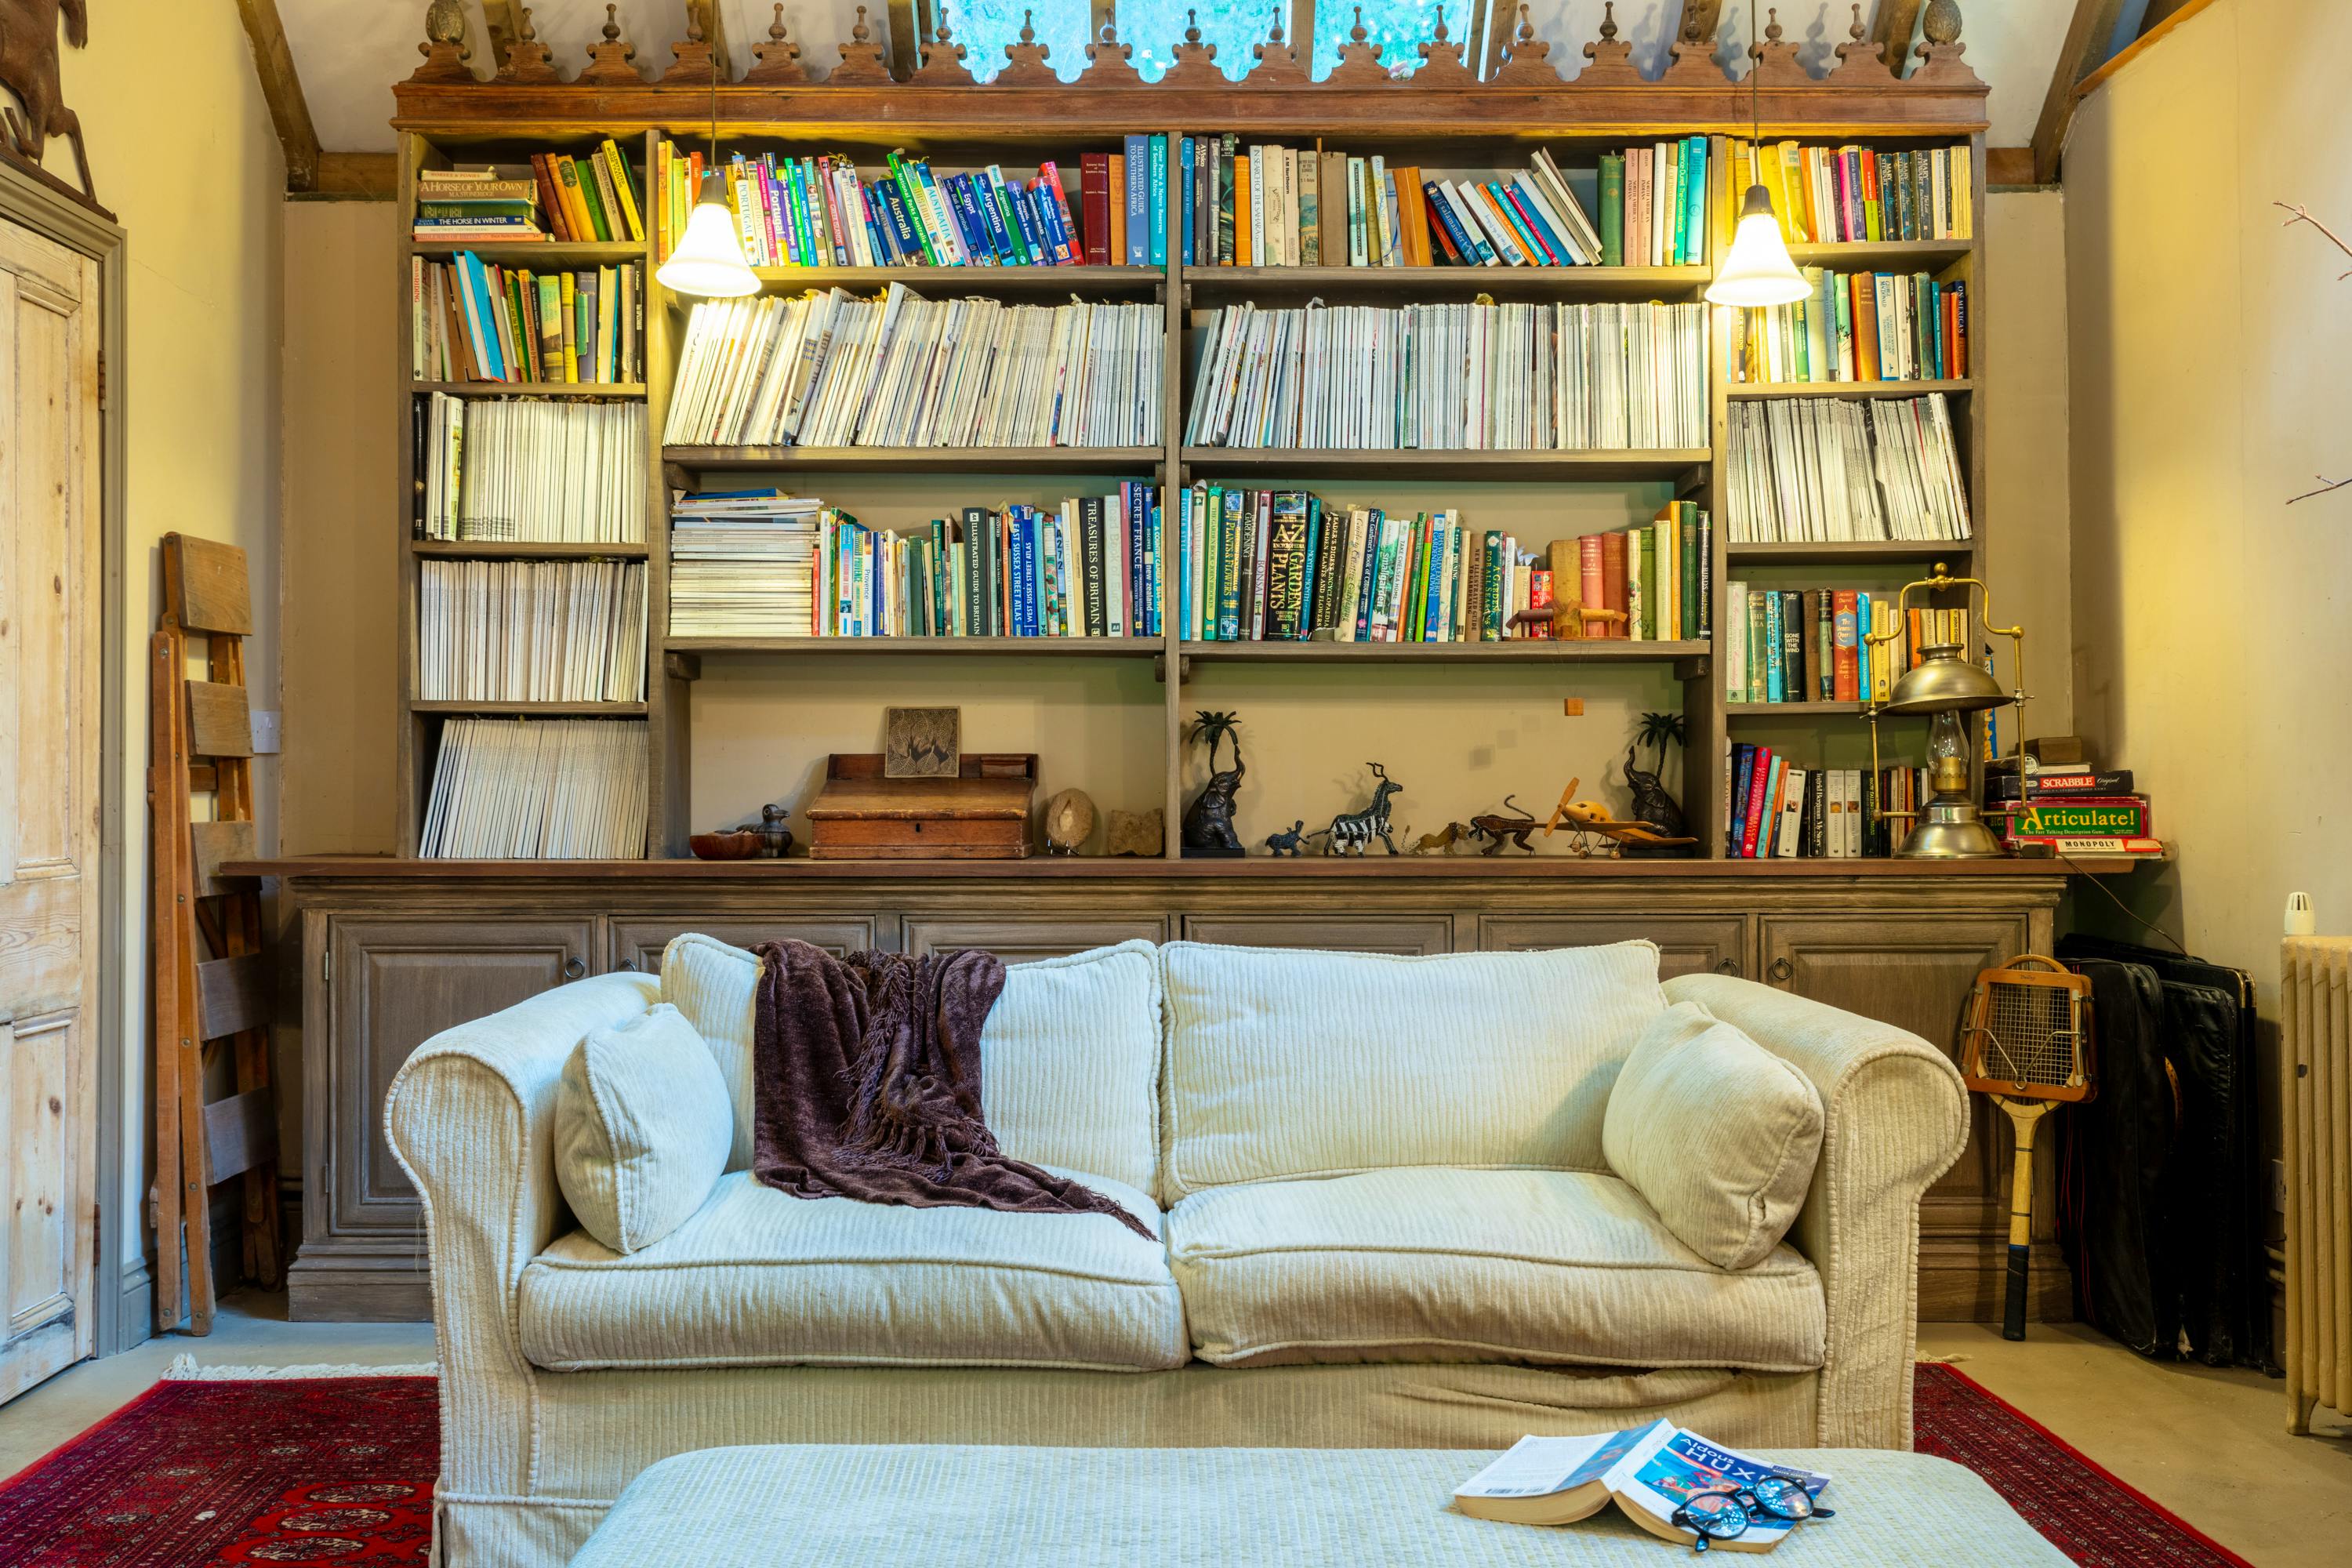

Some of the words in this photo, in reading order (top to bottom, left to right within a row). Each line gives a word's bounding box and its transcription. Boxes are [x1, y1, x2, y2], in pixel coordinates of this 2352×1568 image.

[1130, 144, 1136, 154] TO
[1254, 148, 1260, 157] IN
[1129, 154, 1138, 191] SOUTHERN
[1136, 145, 1145, 190] ILLUSTRATED
[1897, 155, 1906, 185] STEWART
[421, 182, 430, 191] A
[431, 182, 461, 191] HORSE
[474, 182, 498, 191] YOUR
[499, 182, 523, 191] OWN
[1254, 181, 1261, 193] OF
[739, 183, 753, 233] PORTUGAL
[771, 190, 785, 235] Portugal
[783, 189, 794, 226] Scandinavian
[897, 172, 907, 196] National
[906, 195, 916, 214] Parks
[913, 216, 926, 243] Australia
[927, 189, 950, 239] AUSTRALIA
[950, 192, 959, 205] Bali
[956, 209, 968, 232] Lombok
[964, 194, 976, 214] Egypt
[983, 192, 1002, 234] Argentina
[999, 190, 1011, 217] Argentina
[1137, 191, 1145, 214] GUIDE
[889, 197, 911, 239] Australia
[1439, 204, 1465, 244] salamander
[765, 216, 775, 250] PORTUGAL
[1957, 285, 1963, 296] ON
[522, 292, 533, 325] Management
[528, 333, 536, 350] Horses
[530, 355, 539, 372] Ponies
[1133, 486, 1142, 526] SECRET
[1087, 501, 1098, 563] TREASURES
[1224, 521, 1235, 553] PLANTS
[1366, 523, 1376, 553] Gardener's
[1012, 543, 1021, 569] SUSSEX
[1109, 532, 1120, 563] Book
[1305, 549, 1315, 574] MONTH
[853, 557, 862, 583] PROVENCE
[1089, 565, 1098, 580] OF
[1192, 546, 1201, 597] GARDENING
[1222, 559, 1233, 596] FLOWERS
[1254, 559, 1265, 596] BONSAI
[1377, 552, 1388, 607] smallgarden
[1394, 555, 1403, 583] CHELSEA
[1450, 553, 1460, 579] PRUNING
[1013, 572, 1022, 597] STREET
[1270, 553, 1288, 610] PLANTS
[1287, 552, 1305, 610] GARDEN
[1303, 577, 1312, 601] MONTH
[1361, 575, 1370, 595] Colour
[1492, 574, 1501, 610] GARDEN
[973, 594, 978, 604] TO
[1089, 582, 1099, 624] BRITAIN
[1145, 583, 1153, 611] zealand
[1323, 572, 1335, 626] ENCYCLOPAEDIA
[1813, 772, 1823, 789] Ingrid
[2043, 777, 2093, 787] SCRABBLE
[1813, 790, 1823, 818] Bergman
[1813, 820, 1822, 830] My
[2021, 808, 2134, 830] Articulate!
[1813, 830, 1822, 848] Story
[1680, 1437, 1736, 1465] Aldous
